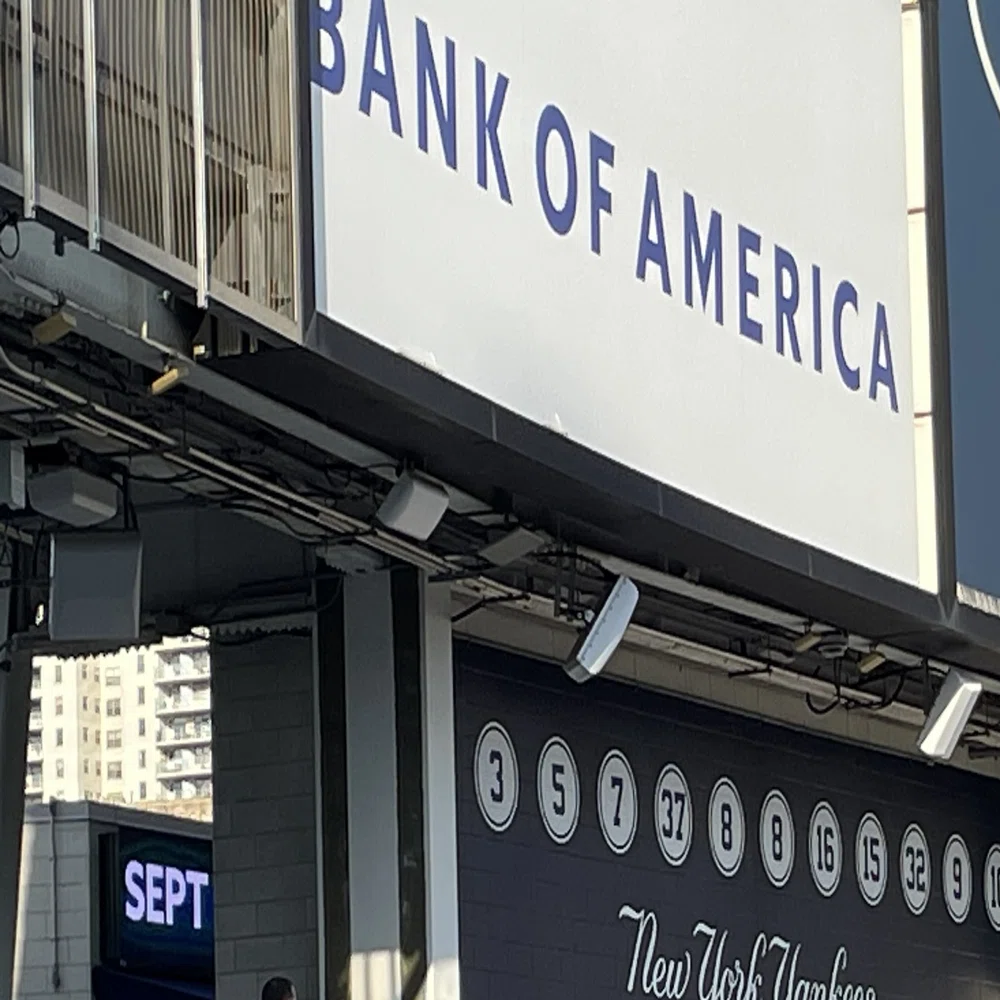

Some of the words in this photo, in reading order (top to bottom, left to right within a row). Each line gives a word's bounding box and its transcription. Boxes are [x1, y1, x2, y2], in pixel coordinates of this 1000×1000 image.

[309, 0, 513, 206] BANK
[535, 104, 615, 255] OF
[636, 168, 899, 413] AMERICA
[490, 750, 504, 803] 3
[552, 763, 566, 816] 5
[611, 775, 623, 826] 7
[661, 789, 685, 840] 37
[721, 803, 732, 851] 8
[772, 814, 783, 861] 8
[817, 825, 834, 872] 16
[863, 836, 880, 882] 15
[906, 847, 926, 892] 32
[124, 859, 209, 930] SEPT
[953, 857, 962, 899] 9
[619, 905, 691, 1000] New
